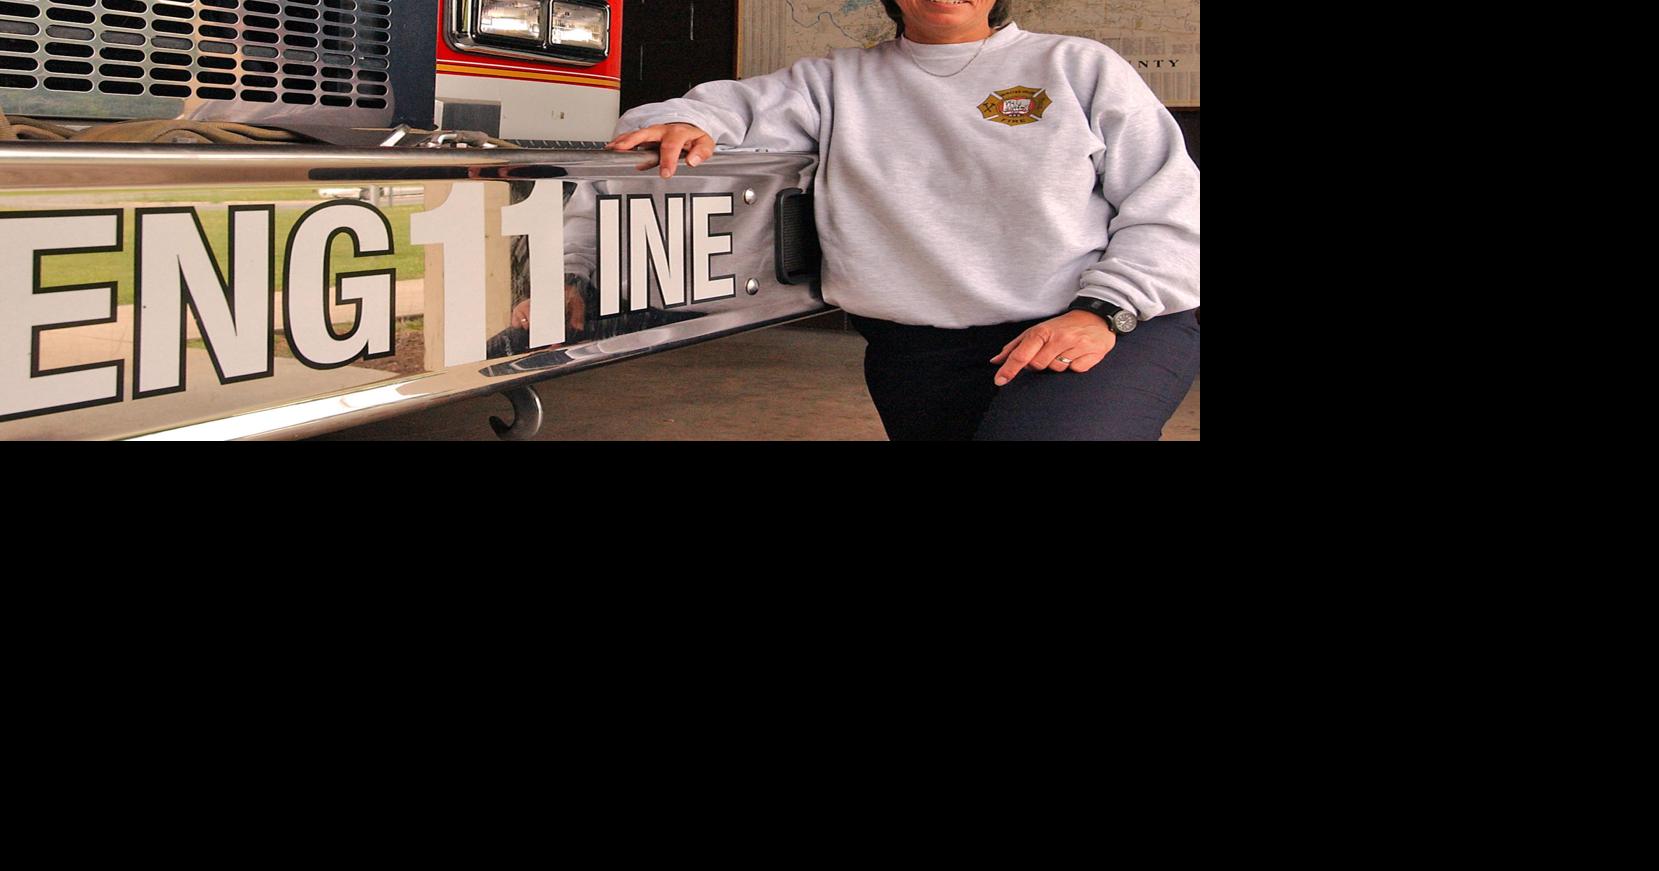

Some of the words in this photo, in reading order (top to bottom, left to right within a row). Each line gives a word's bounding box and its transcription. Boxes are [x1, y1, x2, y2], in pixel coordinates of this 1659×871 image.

[1128, 59, 1179, 68] NTY
[0, 200, 396, 421] ENG
[410, 180, 566, 368] 11
[596, 192, 736, 320] INE
